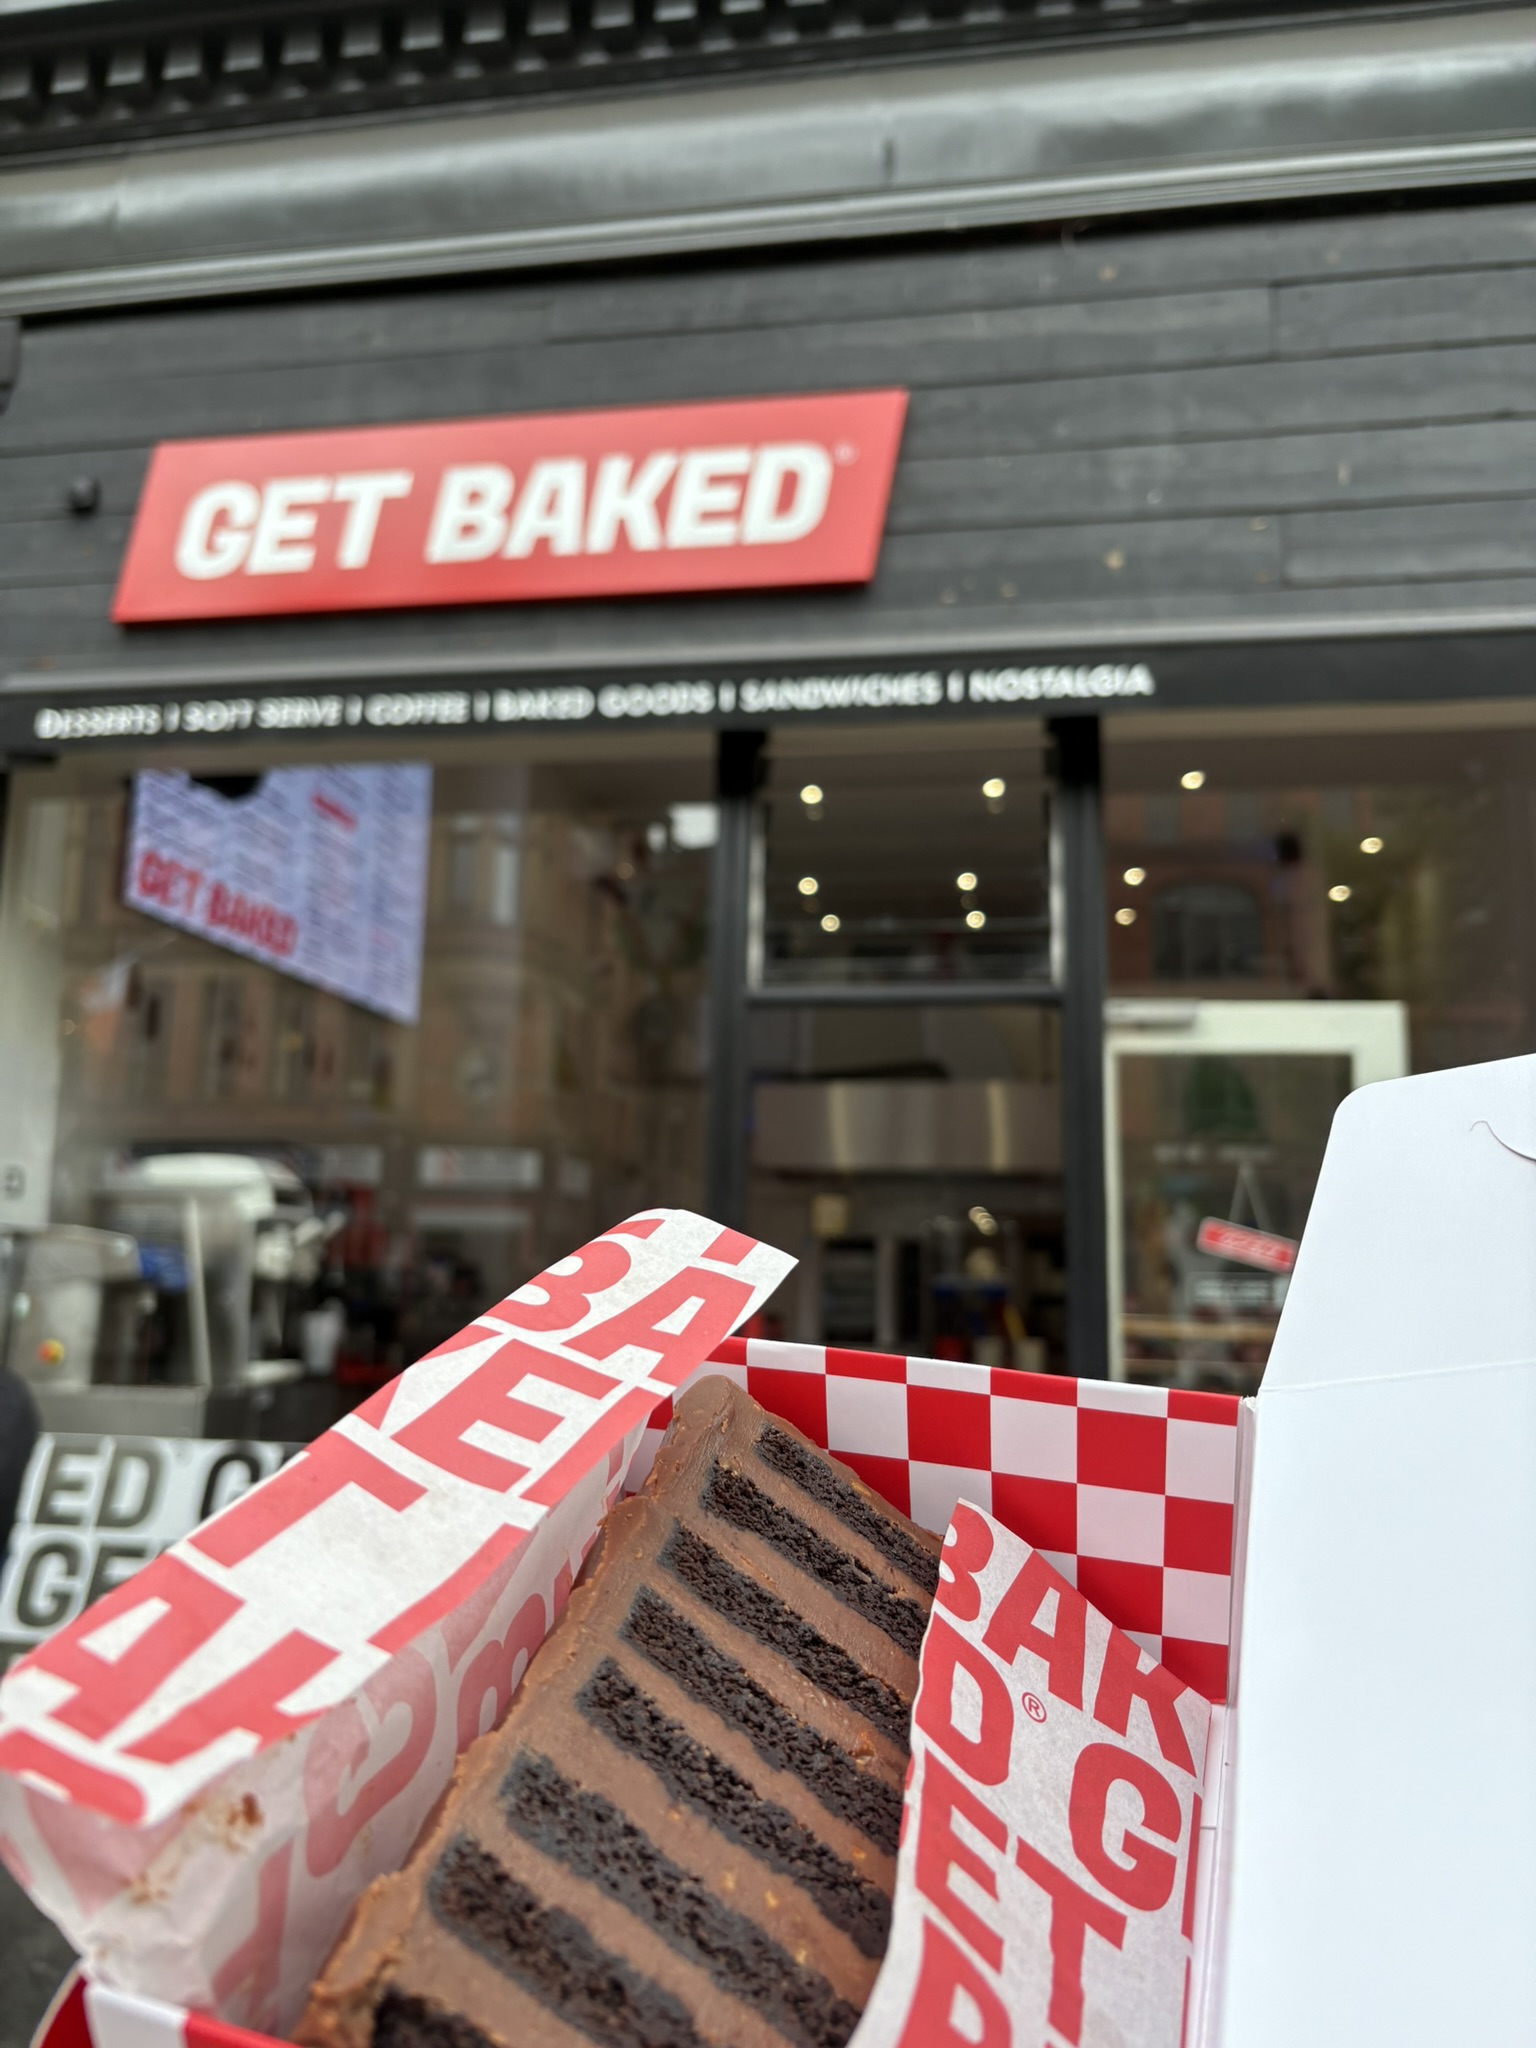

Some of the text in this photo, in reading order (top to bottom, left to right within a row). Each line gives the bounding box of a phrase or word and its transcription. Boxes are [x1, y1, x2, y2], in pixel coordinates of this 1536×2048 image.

[175, 470, 414, 580] GET
[255, 695, 343, 729] SERVE
[364, 692, 470, 726] COFFEE
[493, 686, 595, 722] BAKED
[597, 682, 716, 718] GOODS
[739, 671, 944, 712] SANDWICHES
[968, 663, 1156, 702] NOSTALGIA
[138, 850, 203, 917] GET
